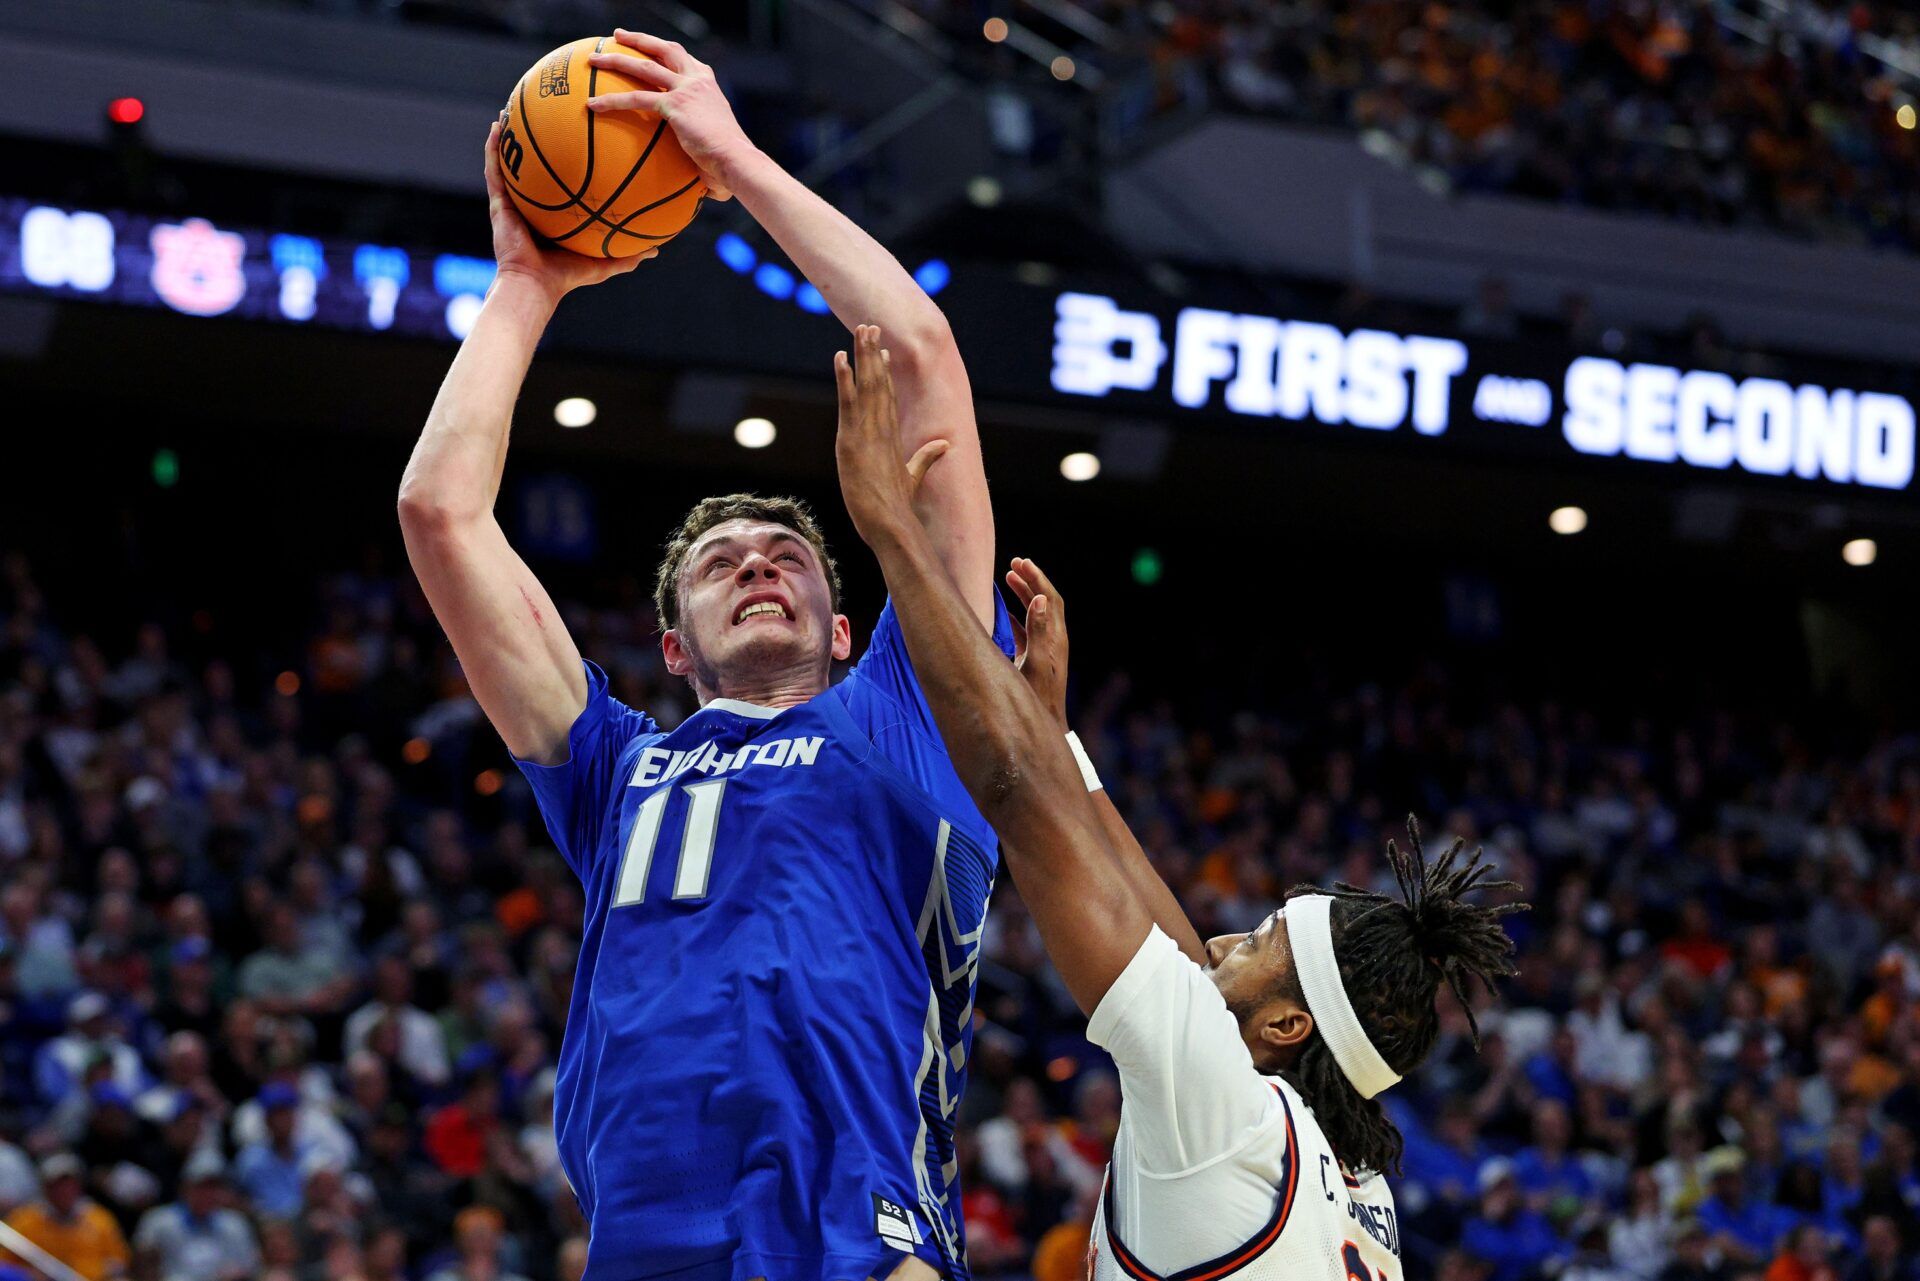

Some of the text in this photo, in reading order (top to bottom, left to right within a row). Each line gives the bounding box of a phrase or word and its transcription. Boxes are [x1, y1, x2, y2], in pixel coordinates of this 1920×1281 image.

[1172, 308, 1916, 489] FIRST AND SECOND
[611, 777, 728, 909] 11
[881, 1199, 903, 1218] 52
